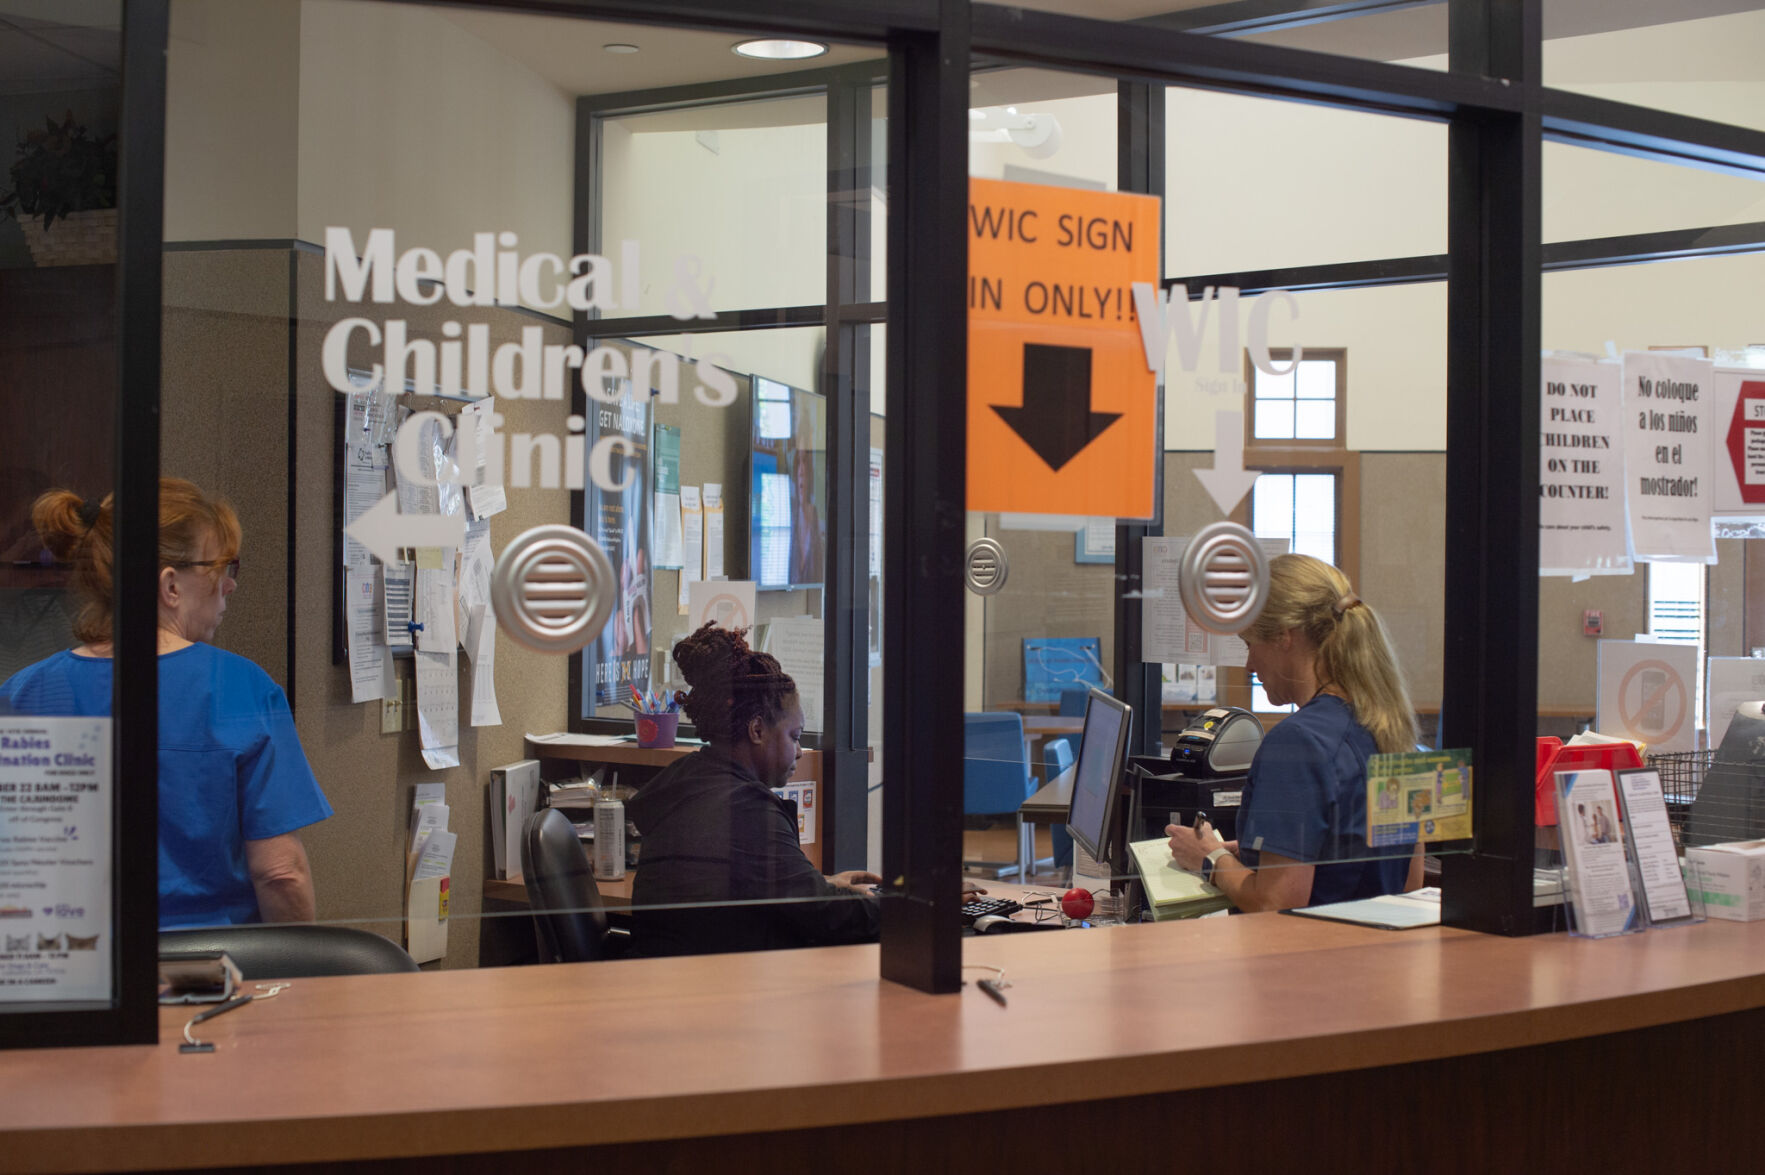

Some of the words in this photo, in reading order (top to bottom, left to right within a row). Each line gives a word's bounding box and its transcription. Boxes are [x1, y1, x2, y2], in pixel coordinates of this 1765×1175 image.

[970, 204, 1038, 243] WIC
[1057, 214, 1134, 253] SIGN
[325, 226, 641, 311] Medical
[665, 254, 718, 321] &
[970, 276, 1003, 311] IN
[1131, 281, 1304, 376] WIC
[322, 317, 739, 408] Children's
[1194, 376, 1227, 396] Sign
[1547, 382, 1566, 397] DO
[1570, 383, 1598, 398] NOT
[1638, 375, 1652, 398] No
[1655, 378, 1699, 403] coloque
[599, 409, 612, 429] GET
[1550, 407, 1596, 424] PLACE
[1639, 411, 1646, 430] a
[1649, 409, 1665, 432] los
[1668, 410, 1698, 433] niños
[1753, 405, 1765, 417] ST
[397, 410, 637, 492] Clinic
[1655, 444, 1670, 465] en
[1672, 444, 1682, 465] el
[1547, 458, 1567, 473] ON
[1572, 459, 1600, 474] THE
[1539, 484, 1609, 500] COUNTER!
[1640, 476, 1698, 498] mostrador!
[1, 736, 51, 749] Rabies
[54, 753, 96, 766] Clinic
